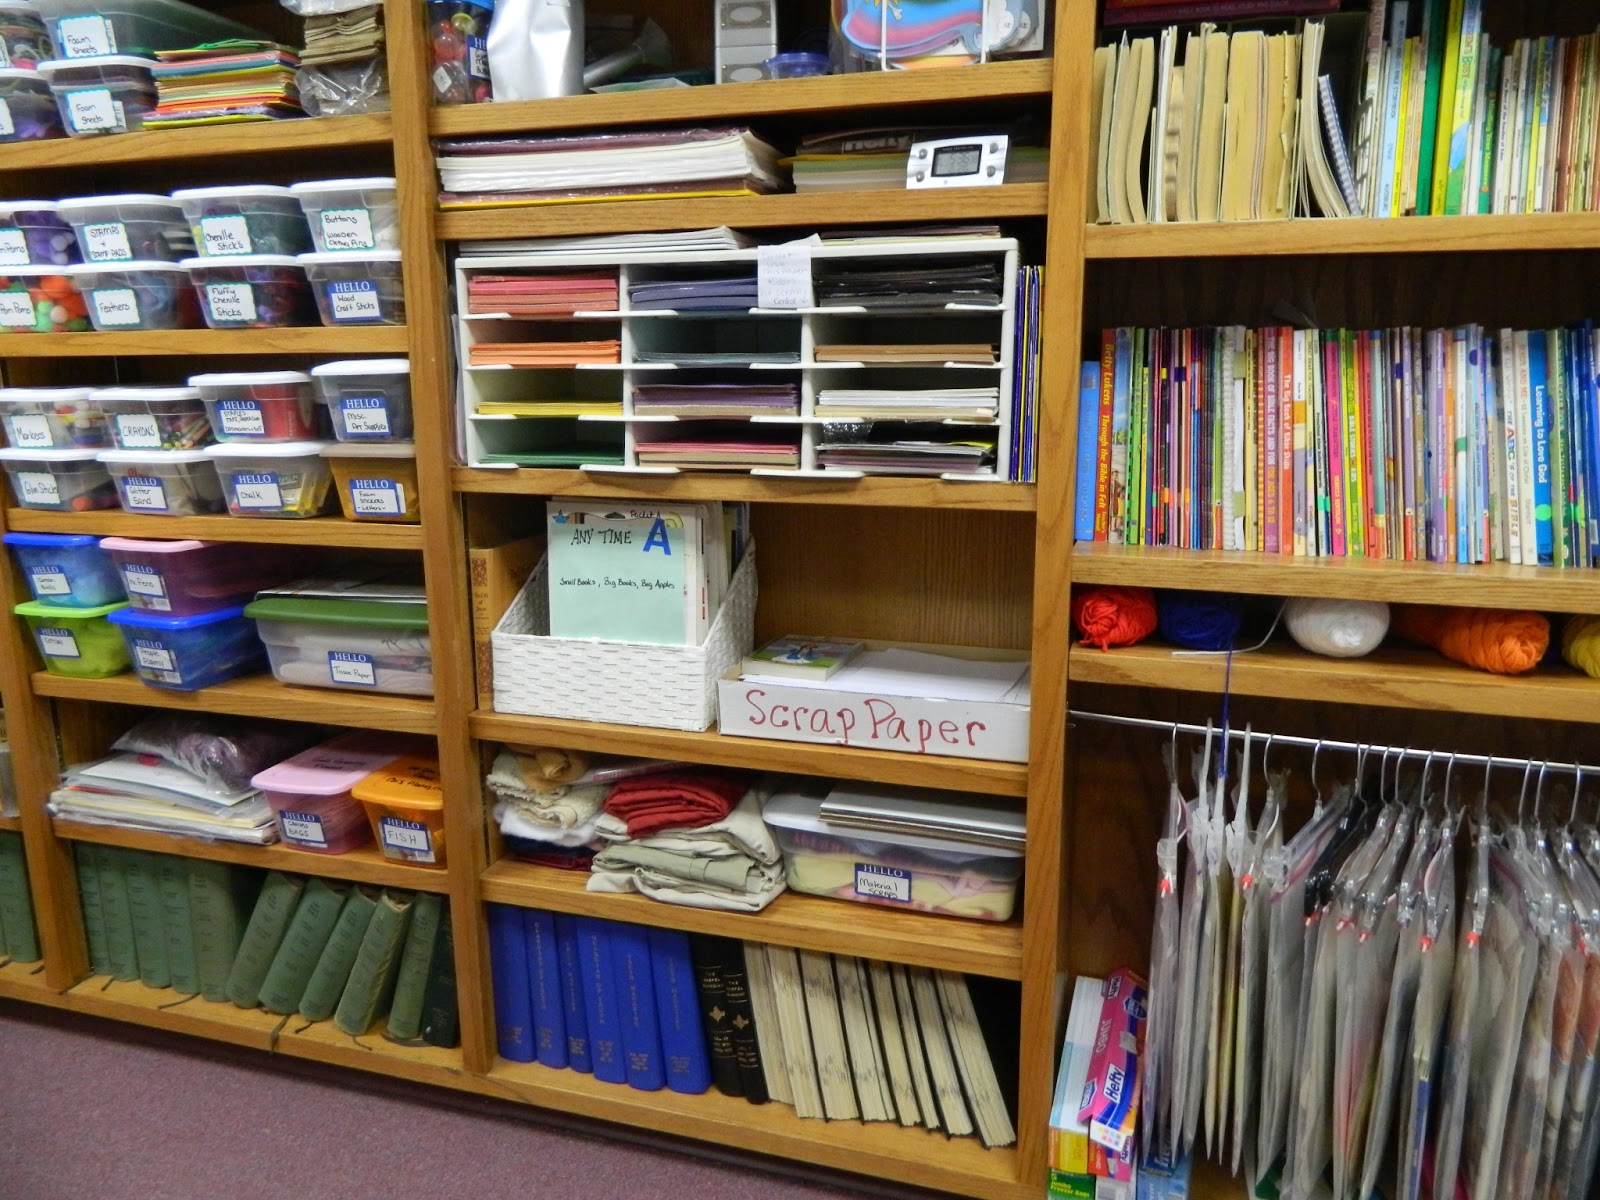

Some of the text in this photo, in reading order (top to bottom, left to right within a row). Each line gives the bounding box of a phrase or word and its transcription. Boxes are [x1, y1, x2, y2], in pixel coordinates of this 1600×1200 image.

[335, 281, 370, 292] HELLO
[1267, 351, 1276, 363] BIG
[1267, 364, 1276, 383] BOOK
[1520, 369, 1528, 385] AND
[1267, 384, 1276, 394] OF
[1282, 390, 1291, 402] Big
[223, 400, 256, 410] HELLO
[346, 398, 380, 409] HELLO
[1267, 394, 1276, 414] BIBLE
[123, 425, 156, 437] CRAYONS
[1098, 343, 1114, 509] Betty Lukens Through the Bible in Felt
[1267, 414, 1276, 436] FACTS
[1534, 385, 1548, 484] Learning to Love God
[1283, 451, 1291, 470] Skills
[128, 477, 157, 486] HELLO
[239, 474, 272, 484] HELLO
[356, 479, 389, 489] HELLO
[1509, 499, 1518, 537] BIBLE
[571, 528, 633, 546] ANY TIME
[642, 518, 672, 556] A
[33, 566, 59, 574] HELLO
[126, 564, 153, 574] HELLO
[560, 577, 576, 586] Small
[603, 576, 616, 588] Big
[41, 628, 68, 637] HELLO
[137, 639, 163, 649] HELLO
[334, 652, 367, 662] HELLO
[745, 689, 986, 754] Scrap Paper
[285, 811, 315, 822] HELLO
[387, 817, 420, 830] HELLO
[388, 830, 417, 845] FISH
[863, 864, 903, 878] HELLO
[860, 877, 898, 892] Material
[1105, 1066, 1125, 1102] Hefty
